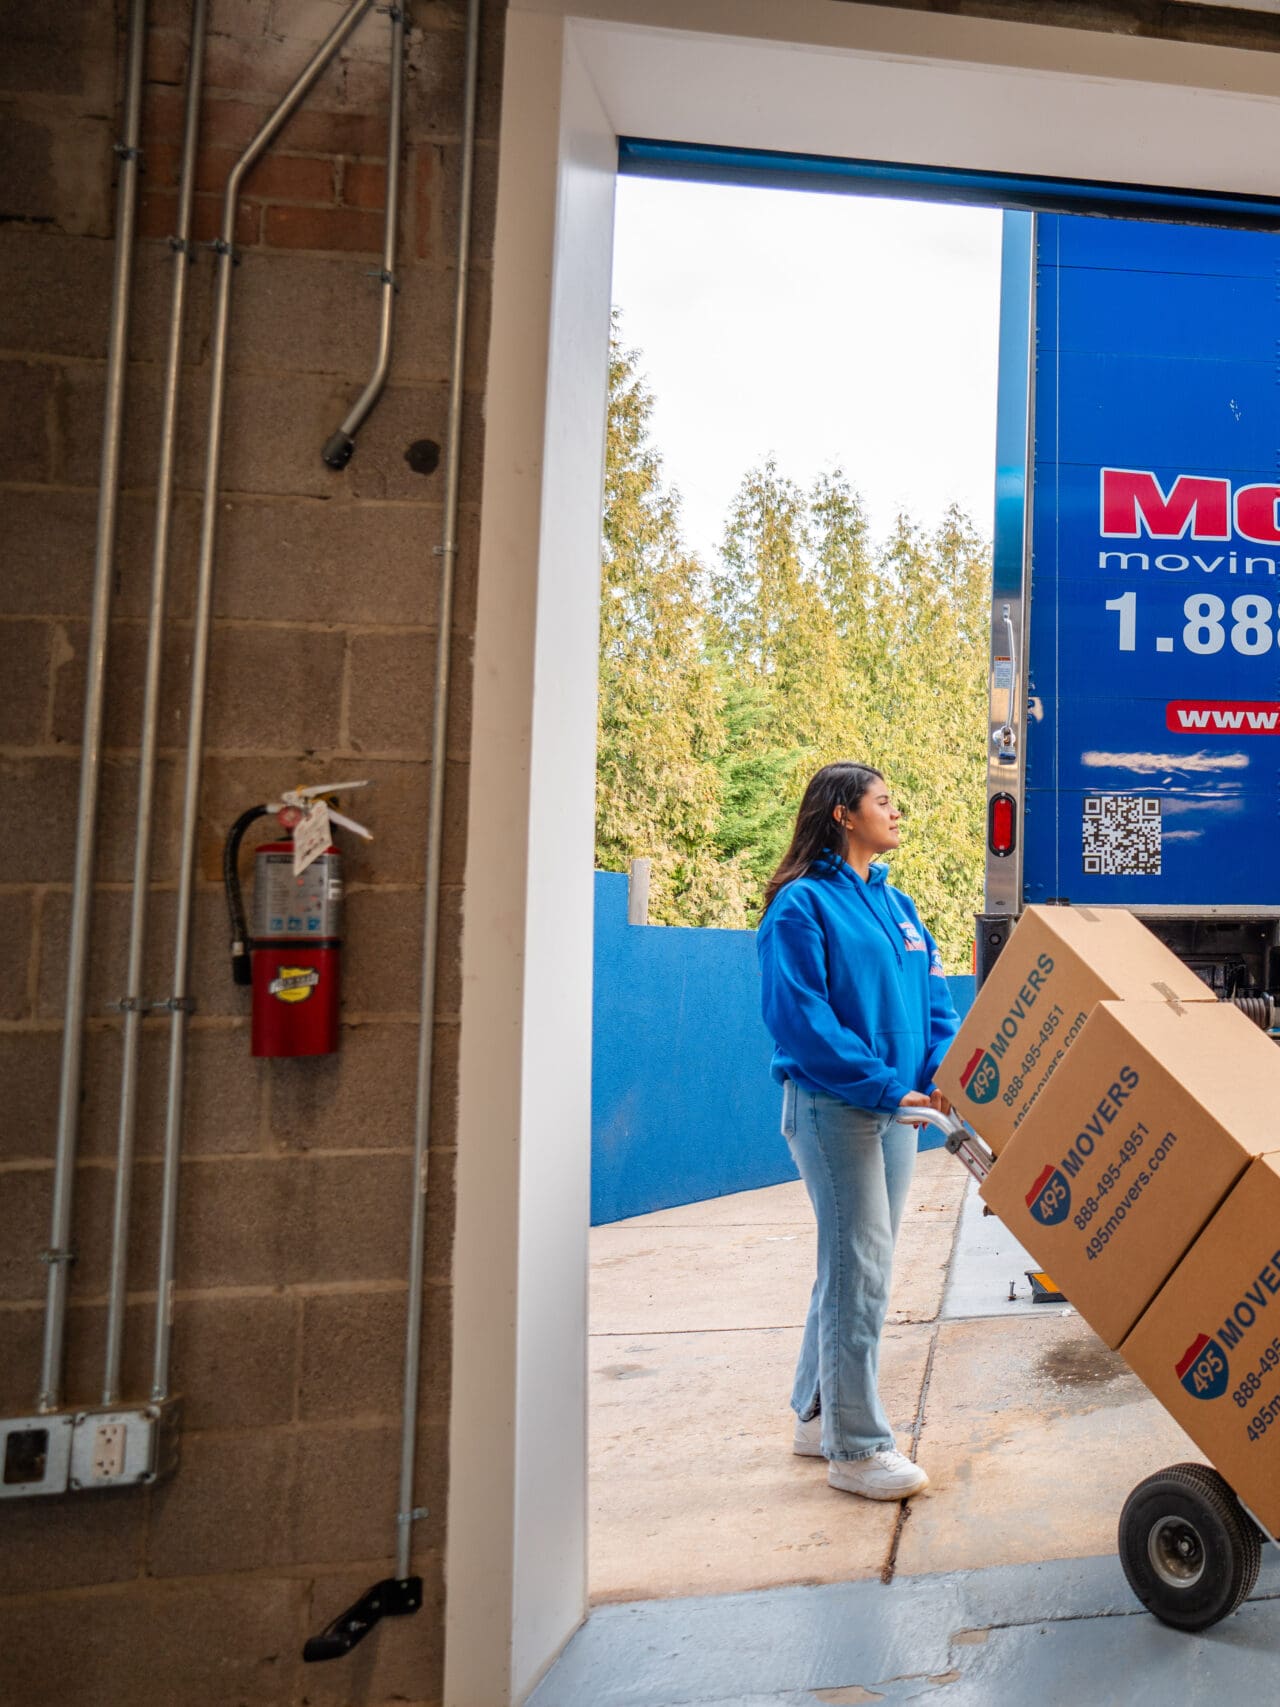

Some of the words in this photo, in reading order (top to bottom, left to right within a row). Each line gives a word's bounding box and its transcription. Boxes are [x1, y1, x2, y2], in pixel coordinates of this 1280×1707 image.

[972, 1061, 996, 1098] 495
[990, 952, 1055, 1061] MOVERS
[1002, 1004, 1065, 1107] 888-495-4951
[1039, 1180, 1066, 1220] 495
[1061, 1065, 1139, 1178] MOVERS
[1073, 1122, 1149, 1231] 888-495-4951
[1085, 1132, 1178, 1261] 495movers.com
[1191, 1350, 1224, 1393] 495
